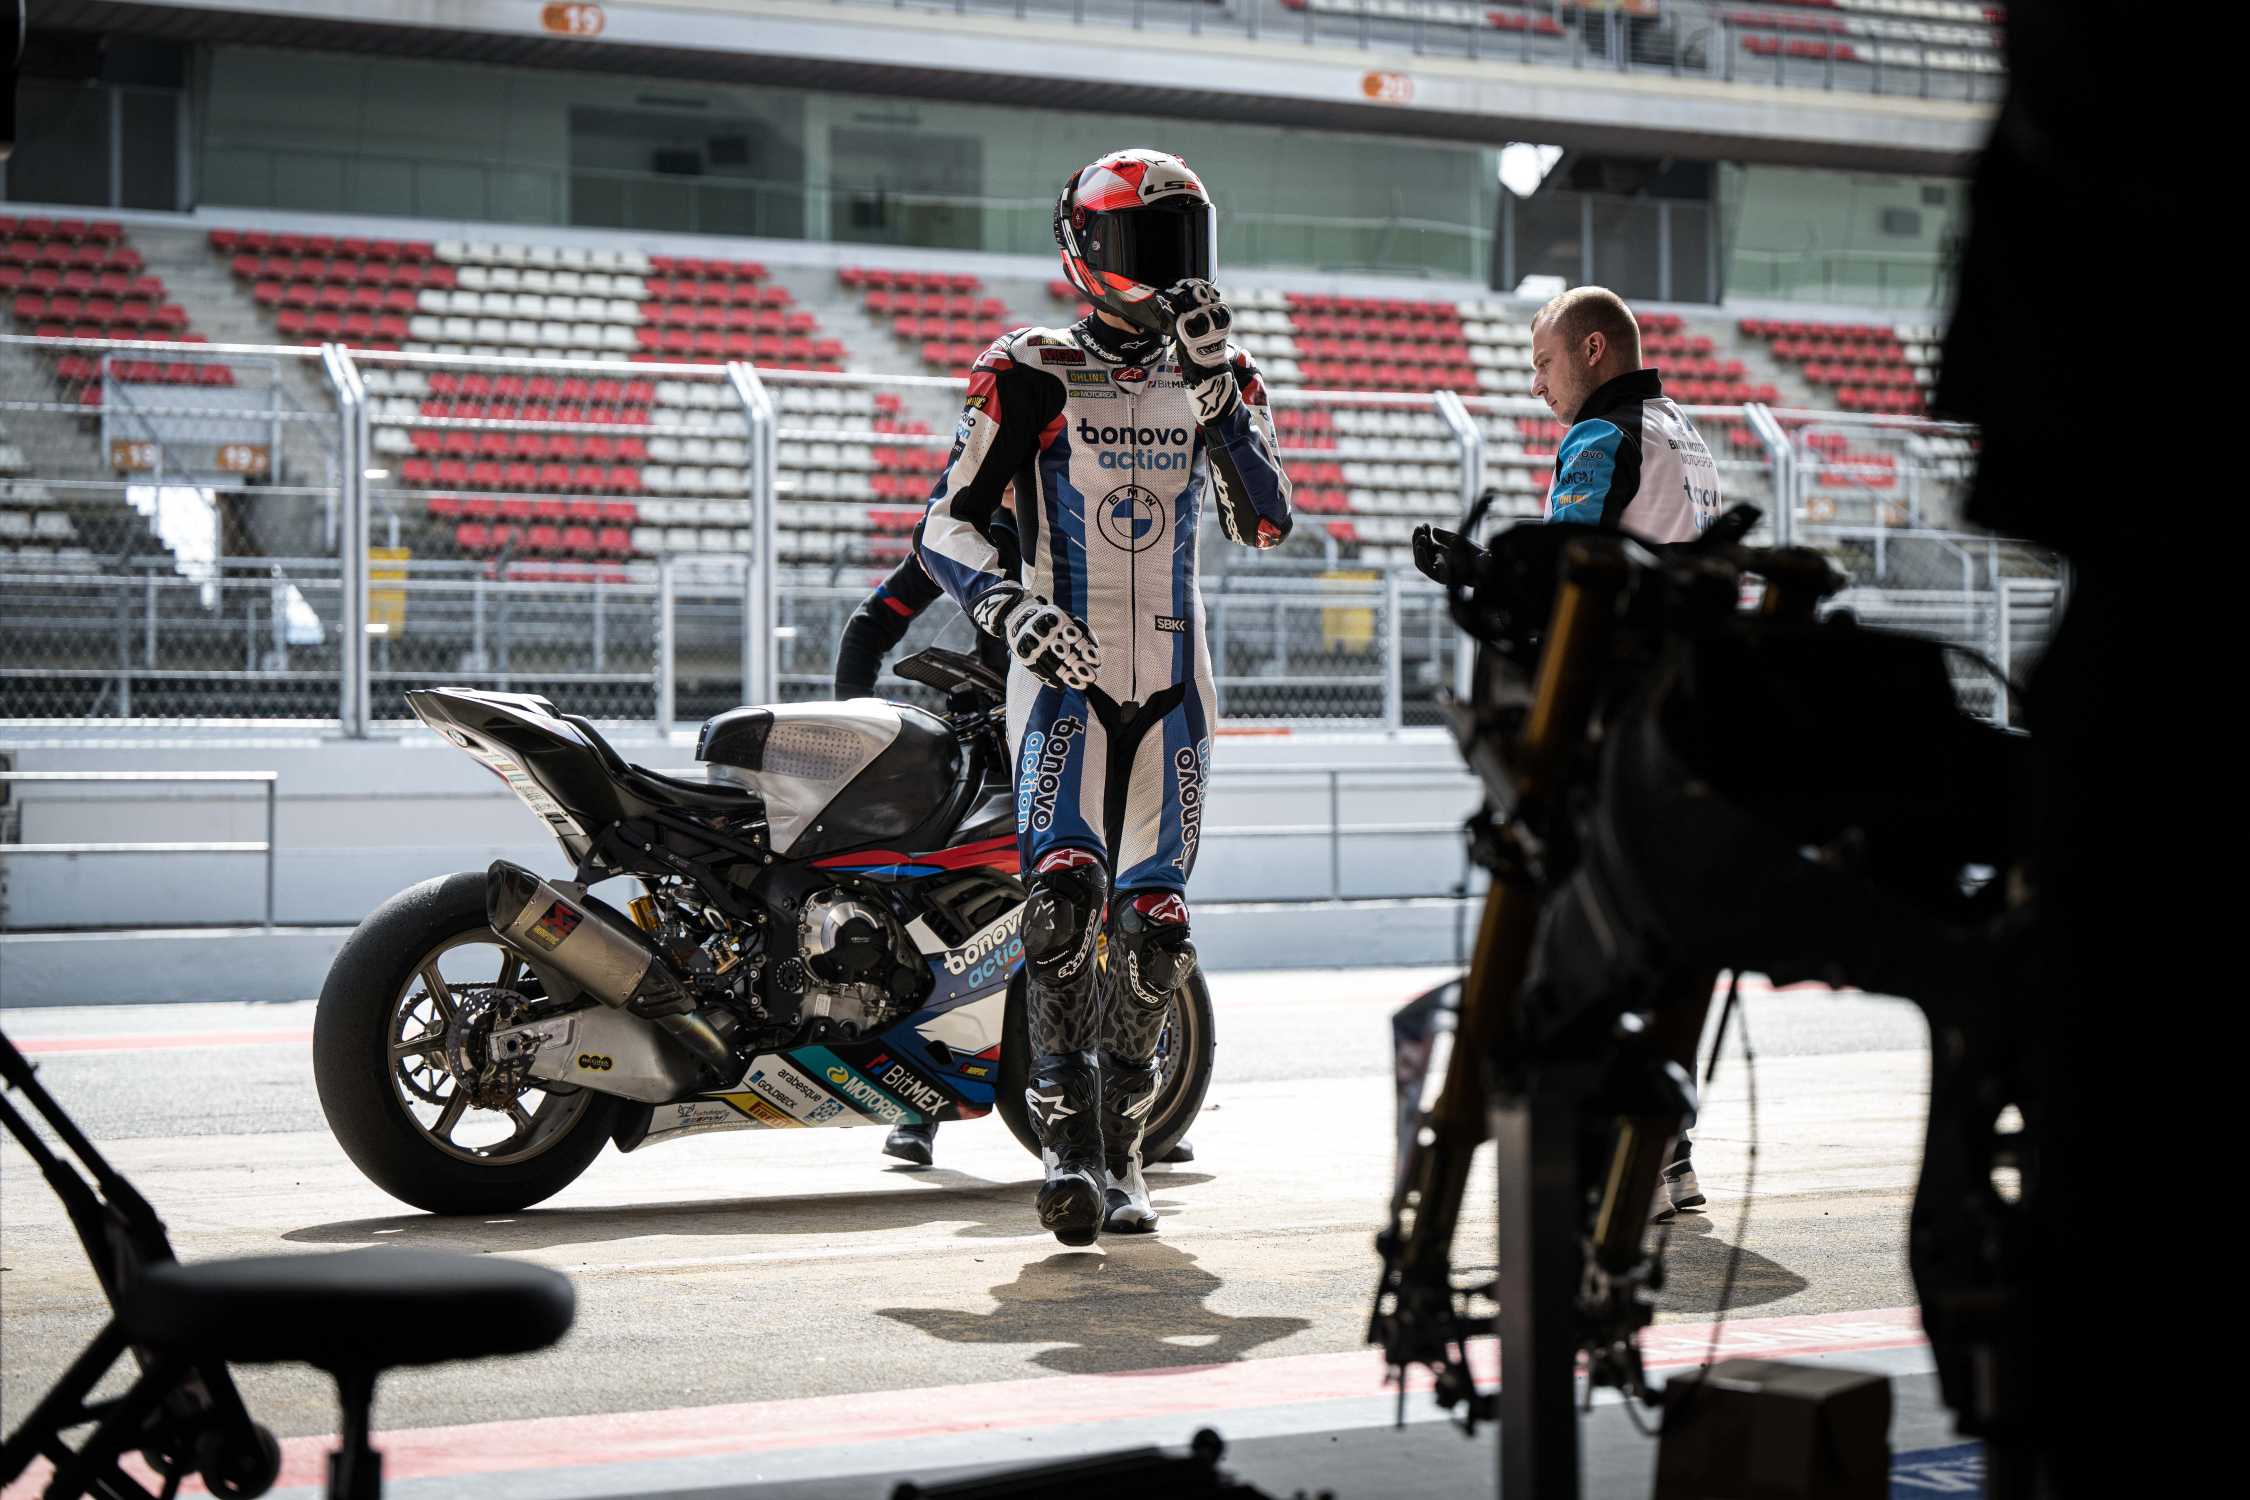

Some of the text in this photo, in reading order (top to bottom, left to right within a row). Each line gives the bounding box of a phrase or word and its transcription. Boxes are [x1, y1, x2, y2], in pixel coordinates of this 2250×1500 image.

[1158, 379, 1186, 389] BitME
[1076, 418, 1188, 446] bonovo
[1098, 448, 1188, 470] action
[1107, 487, 1157, 508] BMW
[1018, 731, 1046, 834] action
[1032, 715, 1086, 833] bonovo
[968, 937, 1022, 989] actio
[757, 1080, 798, 1109] GOLDBECK
[777, 1068, 822, 1102] arabesque
[842, 1076, 908, 1124] MOTOREX
[882, 1064, 950, 1117] BitMEX
